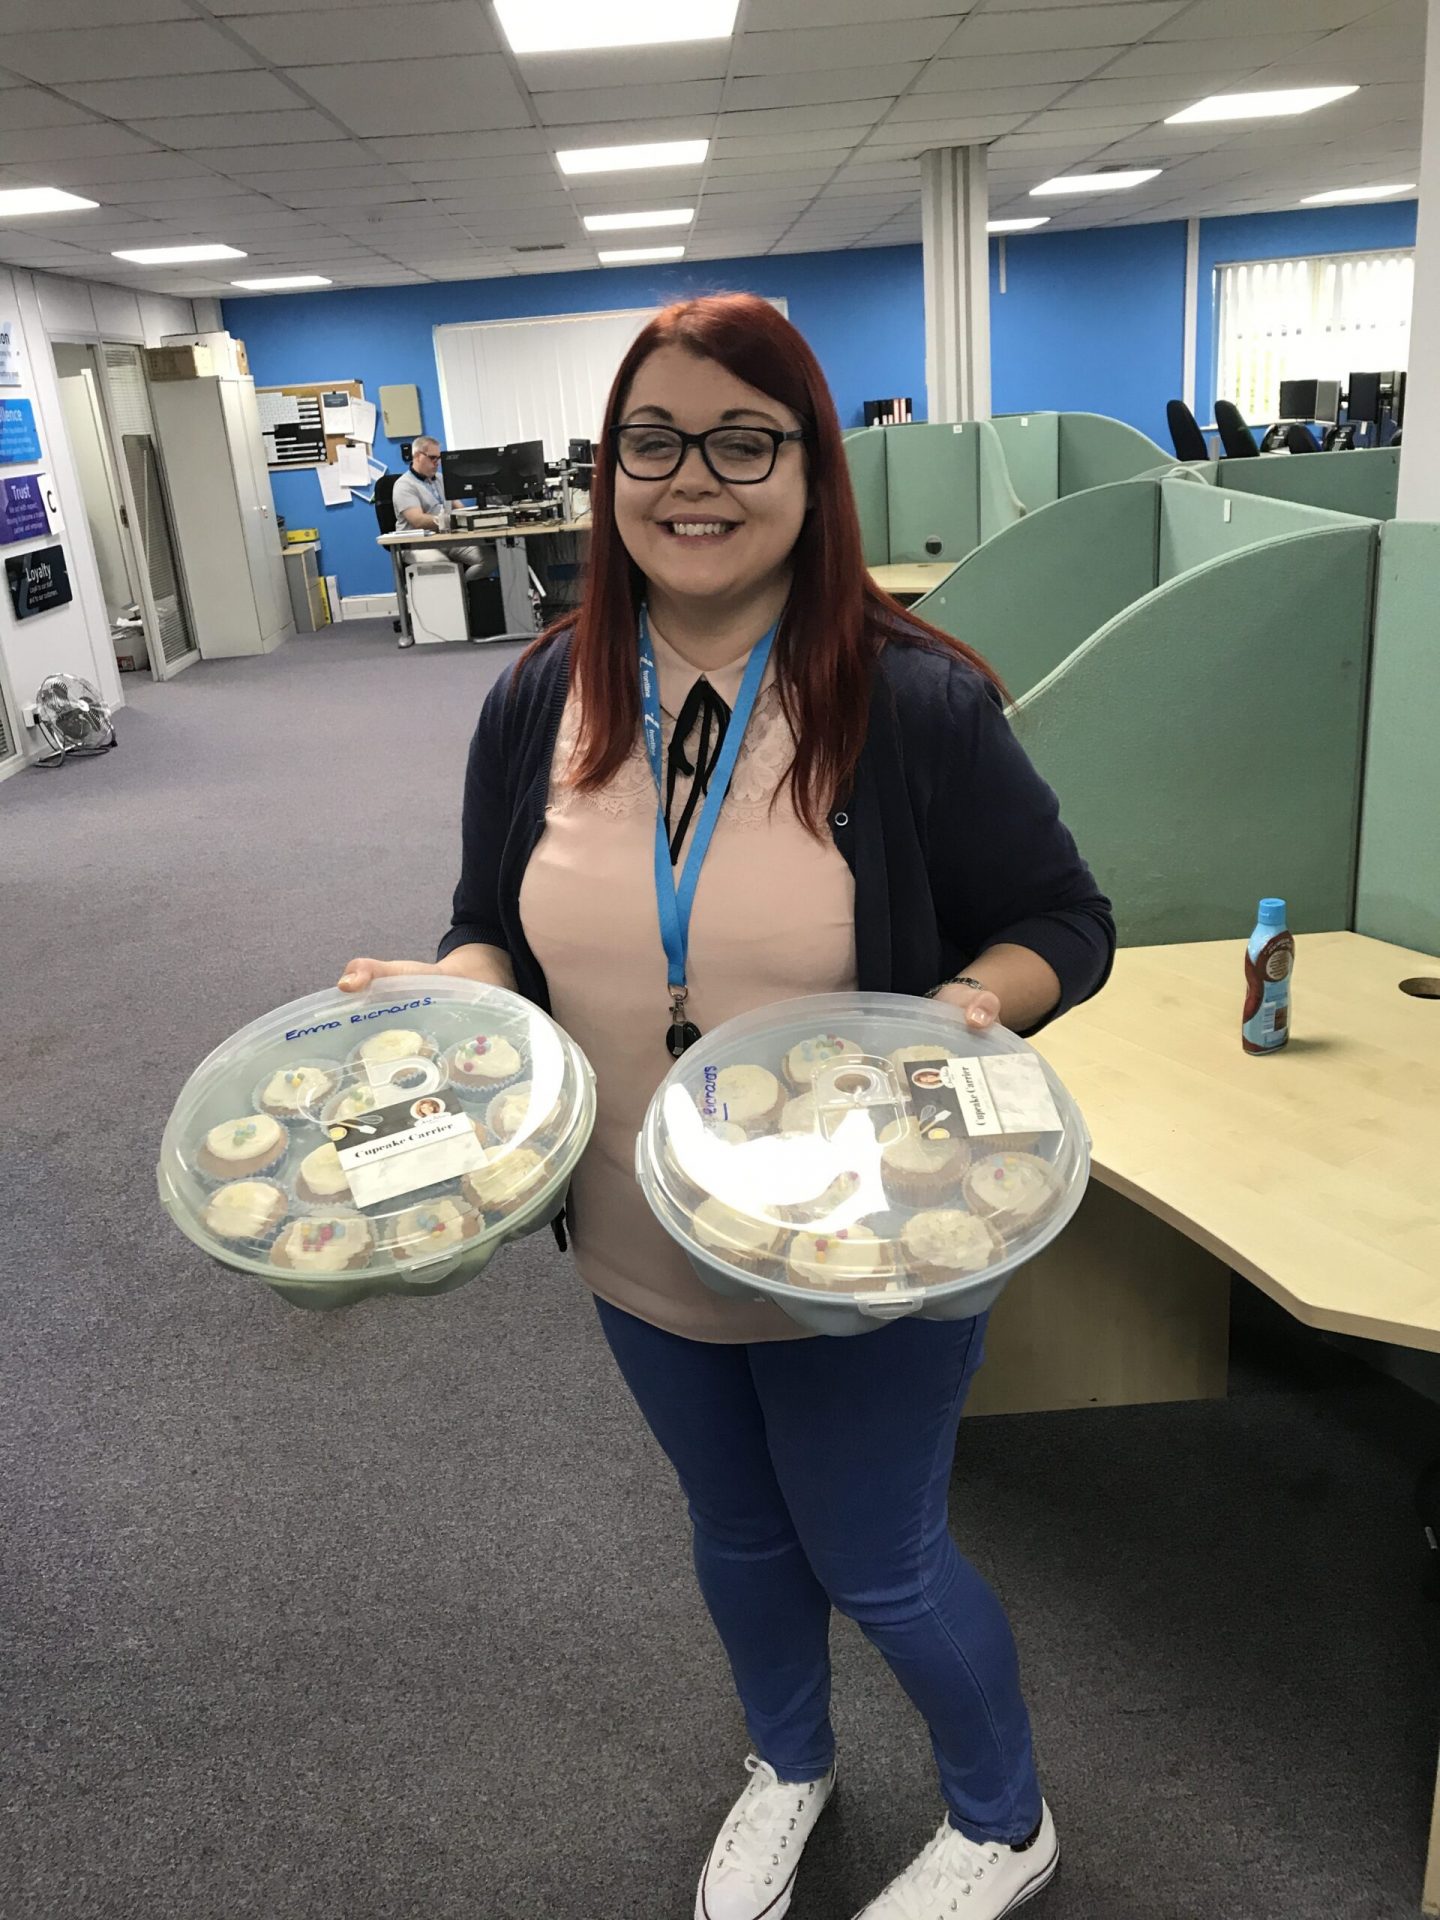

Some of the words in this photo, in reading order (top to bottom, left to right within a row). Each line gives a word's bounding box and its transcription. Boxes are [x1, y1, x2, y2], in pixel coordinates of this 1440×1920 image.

[11, 483, 31, 500] Trust
[25, 562, 51, 584] Loyalty
[285, 1021, 342, 1041] Emma
[961, 1066, 976, 1094] Carrier
[969, 1094, 986, 1126] Cupcake
[354, 1138, 406, 1158] Cupcake
[408, 1123, 453, 1141] Carrier
